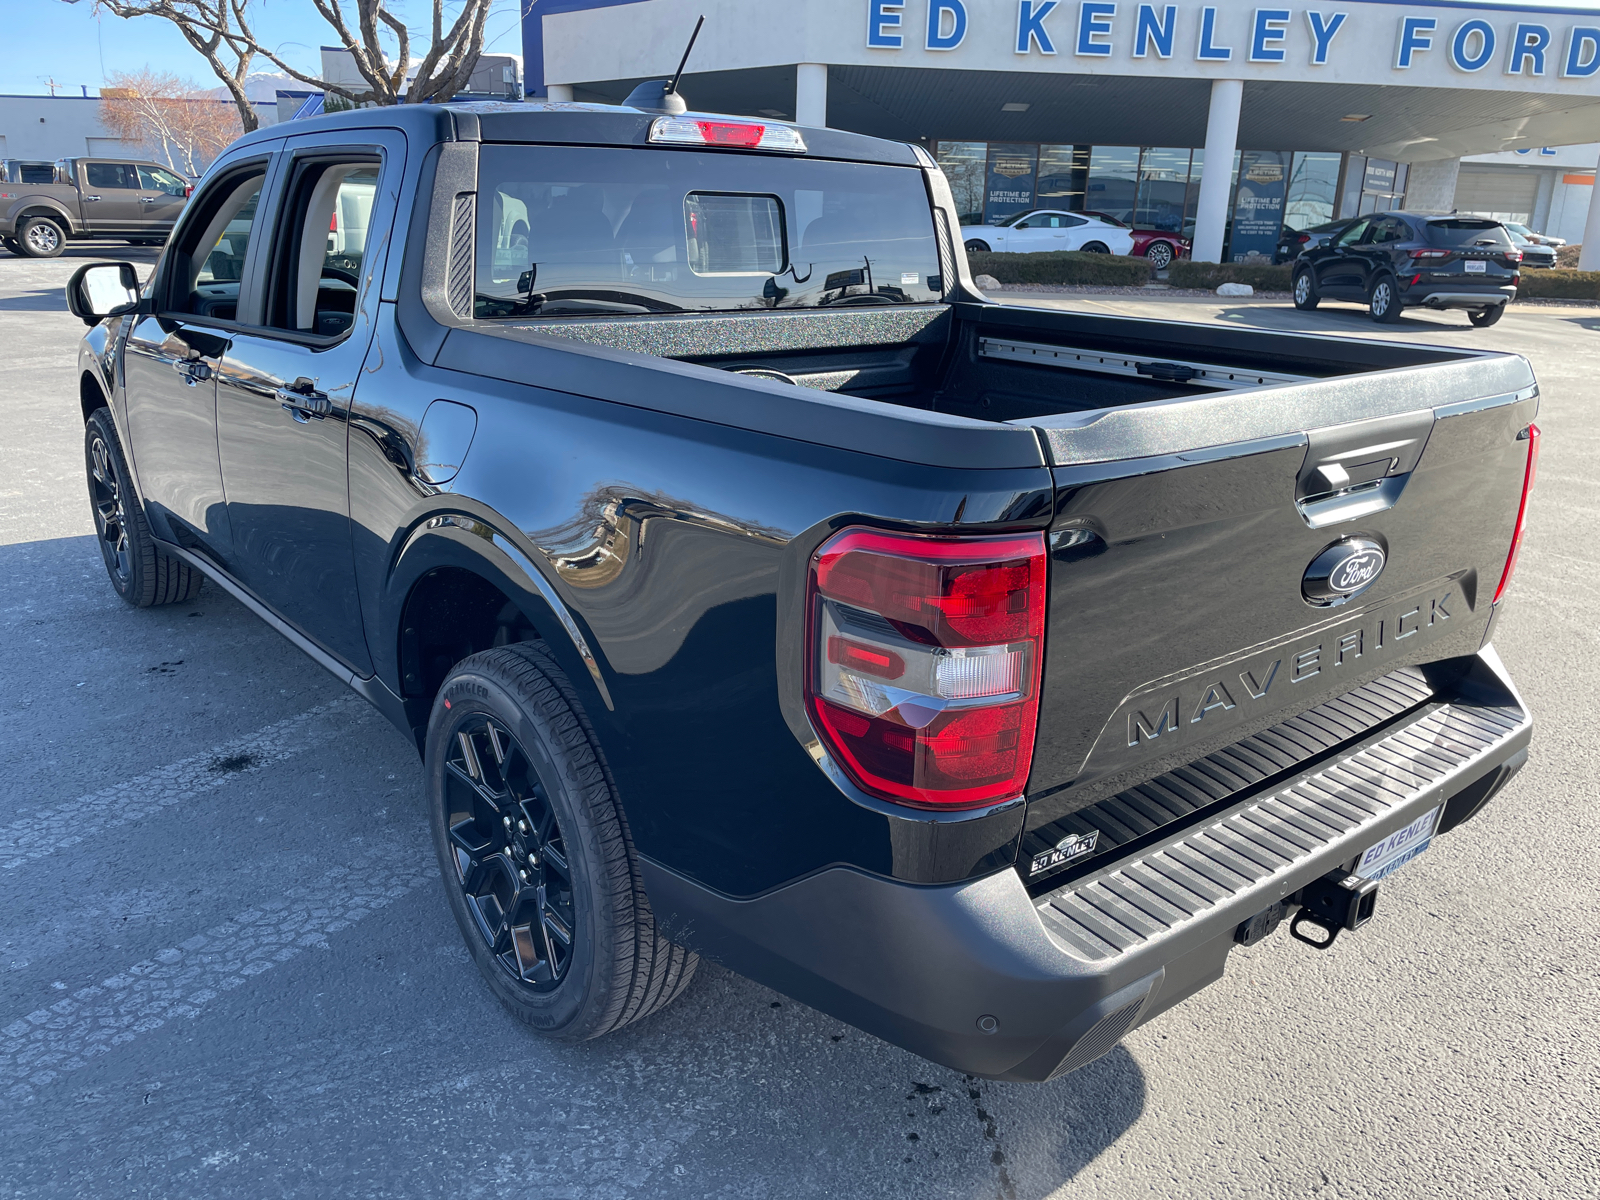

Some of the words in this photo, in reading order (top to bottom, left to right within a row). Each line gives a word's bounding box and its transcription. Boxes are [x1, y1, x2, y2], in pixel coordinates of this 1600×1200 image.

[866, 0, 968, 50] ED
[1014, 0, 1350, 65] KENLEY
[1392, 15, 1600, 78] FORD
[1340, 555, 1376, 587] Ford
[443, 682, 489, 700] WRANGLER
[1127, 592, 1452, 747] MAVERICK
[1031, 856, 1049, 872] ED
[1050, 836, 1097, 864] KENLEY
[1363, 841, 1386, 866] ED
[1386, 808, 1438, 852] KENLEY
